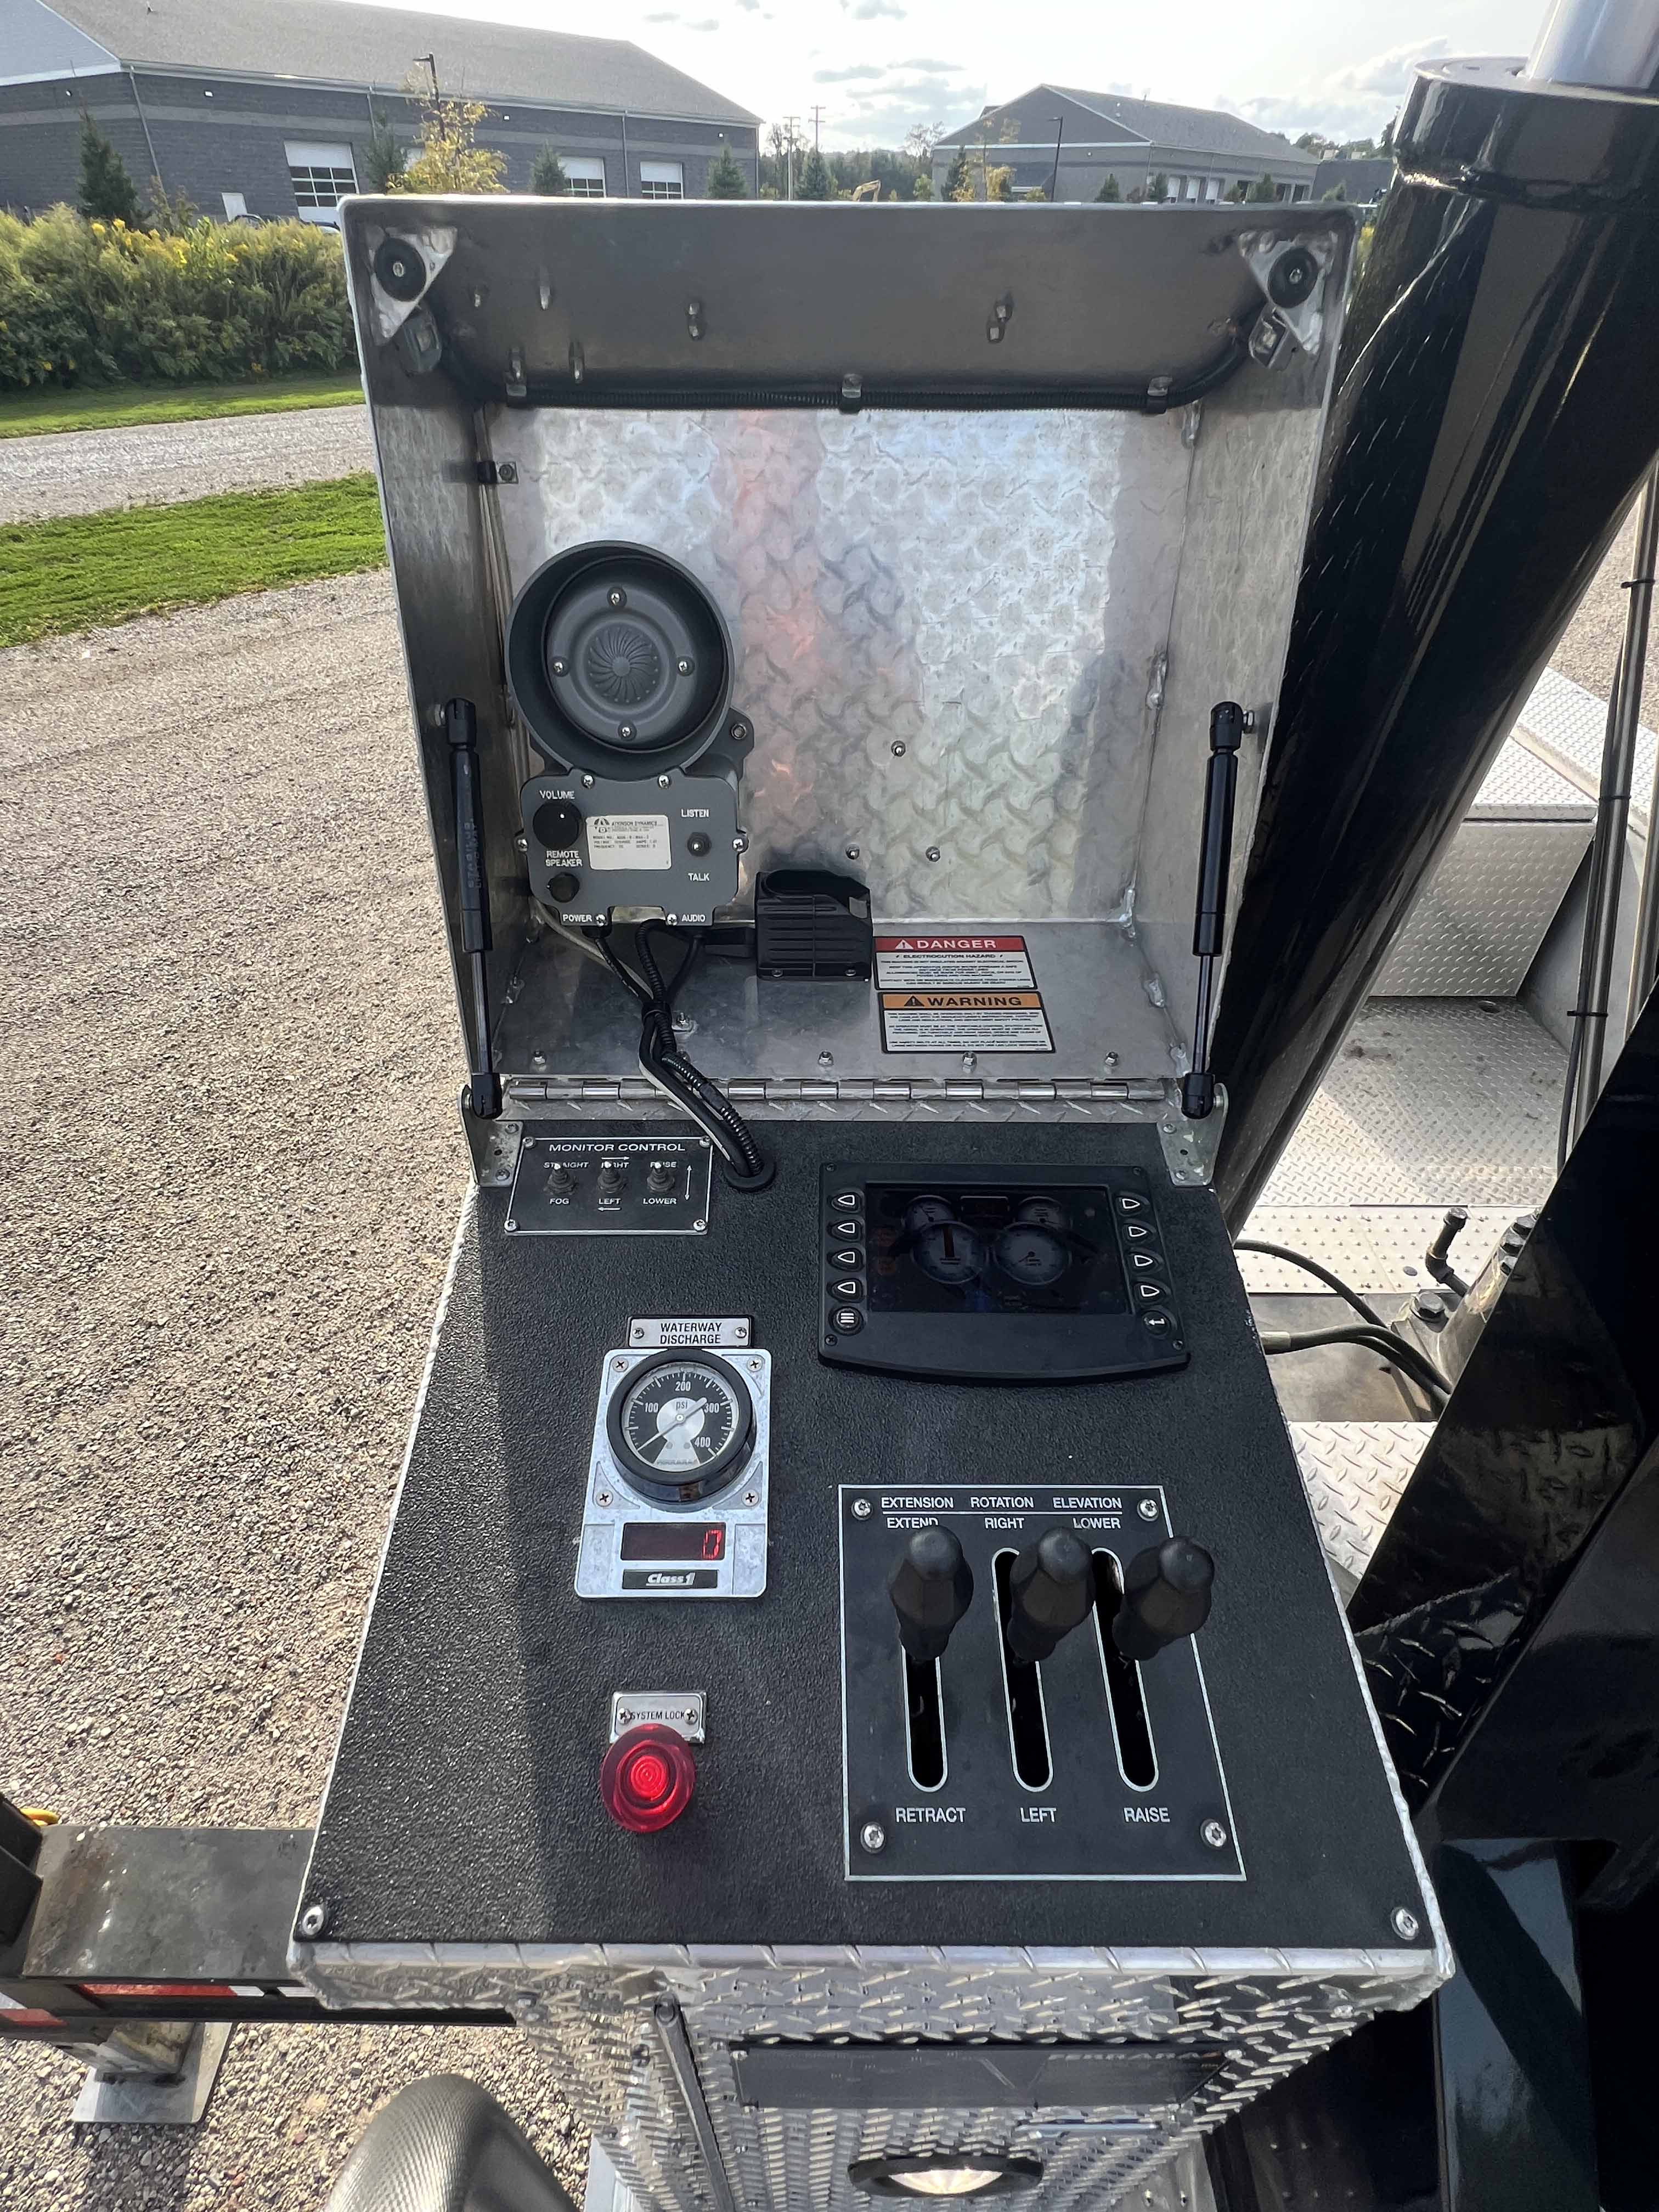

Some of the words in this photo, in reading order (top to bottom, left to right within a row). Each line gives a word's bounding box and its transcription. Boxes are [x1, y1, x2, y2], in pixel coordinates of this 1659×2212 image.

[540, 791, 575, 799] VOLUME
[681, 809, 709, 817] LISTEN
[546, 850, 579, 859] REMOTE
[545, 859, 582, 867] SPEAKER
[688, 873, 710, 882] TALK
[562, 914, 592, 923] POWER
[681, 914, 706, 923] AUDIO
[917, 940, 996, 949] DANGER
[927, 997, 1022, 1006] WARNING
[660, 1323, 722, 1333] WATERWAY
[660, 1335, 721, 1344] DISCHARGE
[675, 1381, 691, 1391] 200
[645, 1403, 658, 1413] 100
[675, 1401, 688, 1410] psi
[704, 1403, 720, 1413] 300
[694, 1437, 711, 1448] 400
[881, 1497, 953, 1509] EXTENSION
[970, 1497, 1034, 1508] ROTATION
[1053, 1498, 1122, 1509] ELEVATION
[984, 1517, 1024, 1529] RIGHT
[1073, 1518, 1121, 1529] LOWER
[702, 1530, 723, 1560] 0
[631, 1711, 663, 1720] SYSTEM
[665, 1711, 684, 1719] LOCK
[895, 1808, 966, 1822] RETRACT
[1020, 1808, 1057, 1822] LEFT
[1124, 1808, 1170, 1822] RAISE
